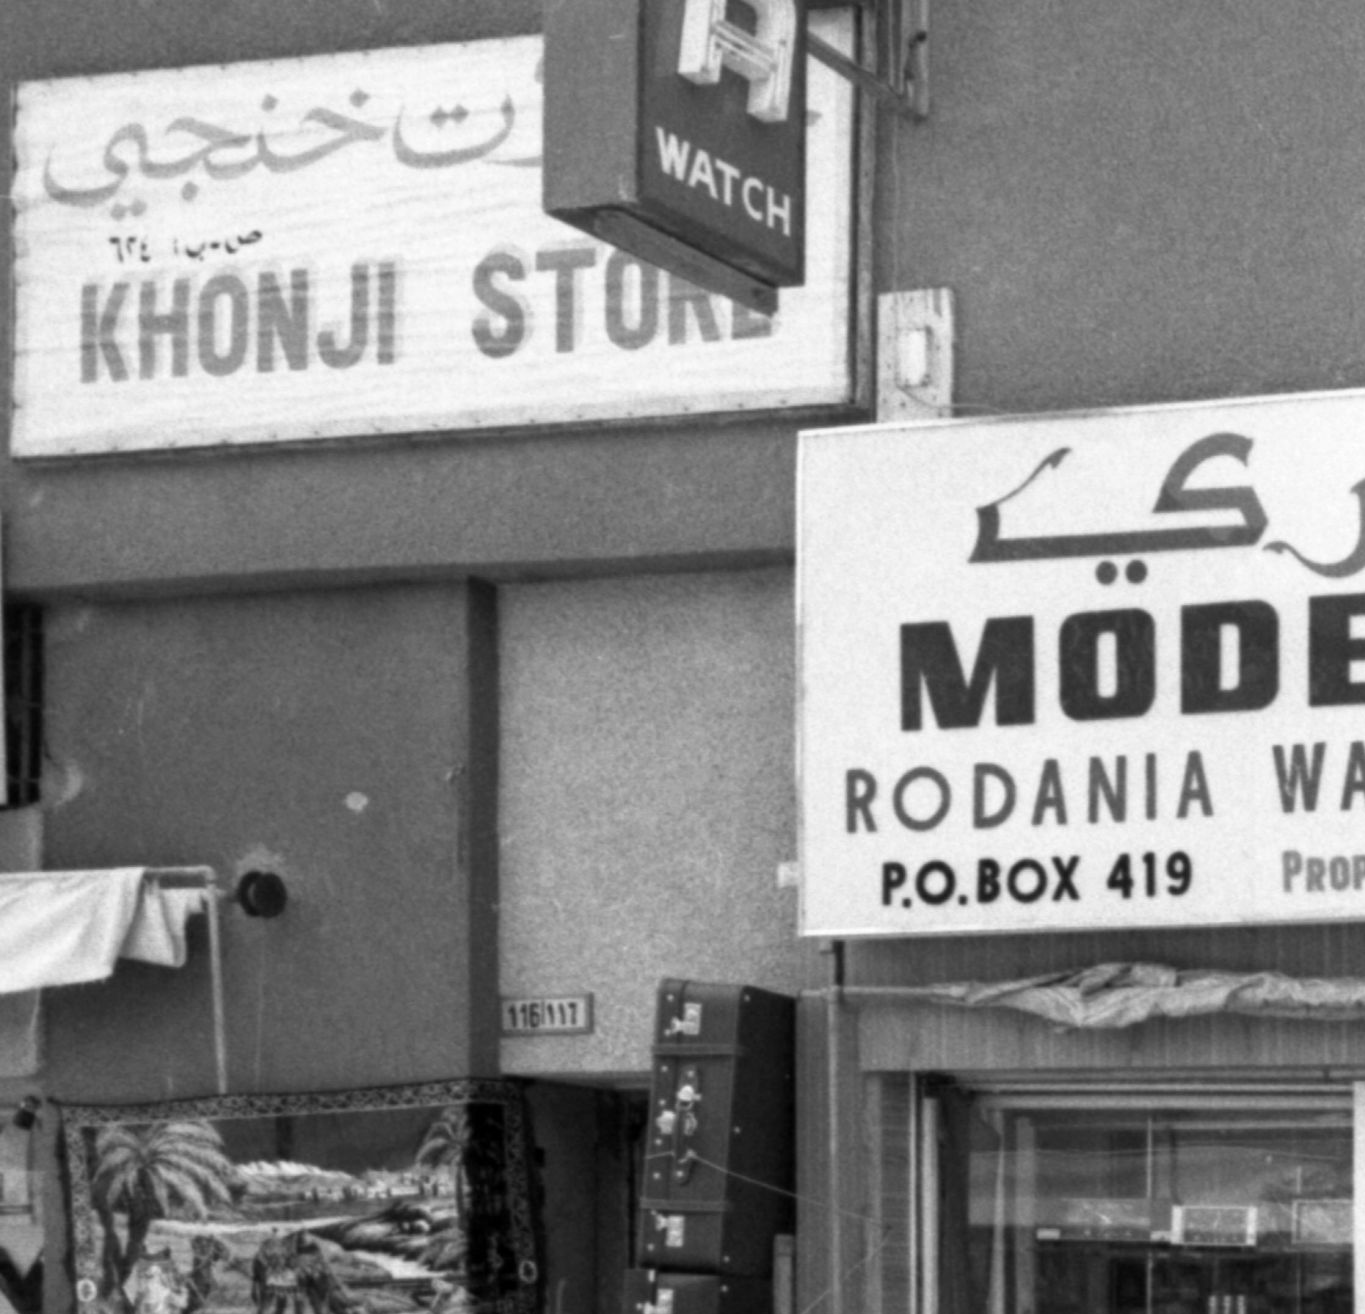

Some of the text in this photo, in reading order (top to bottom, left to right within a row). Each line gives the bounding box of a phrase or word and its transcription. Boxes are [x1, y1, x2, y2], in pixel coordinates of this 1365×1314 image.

[655, 126, 791, 237] WATCH
[80, 260, 397, 384] KHONJI
[845, 750, 1215, 834] RODANIA
[881, 850, 1194, 909] P.O.BOX 419
